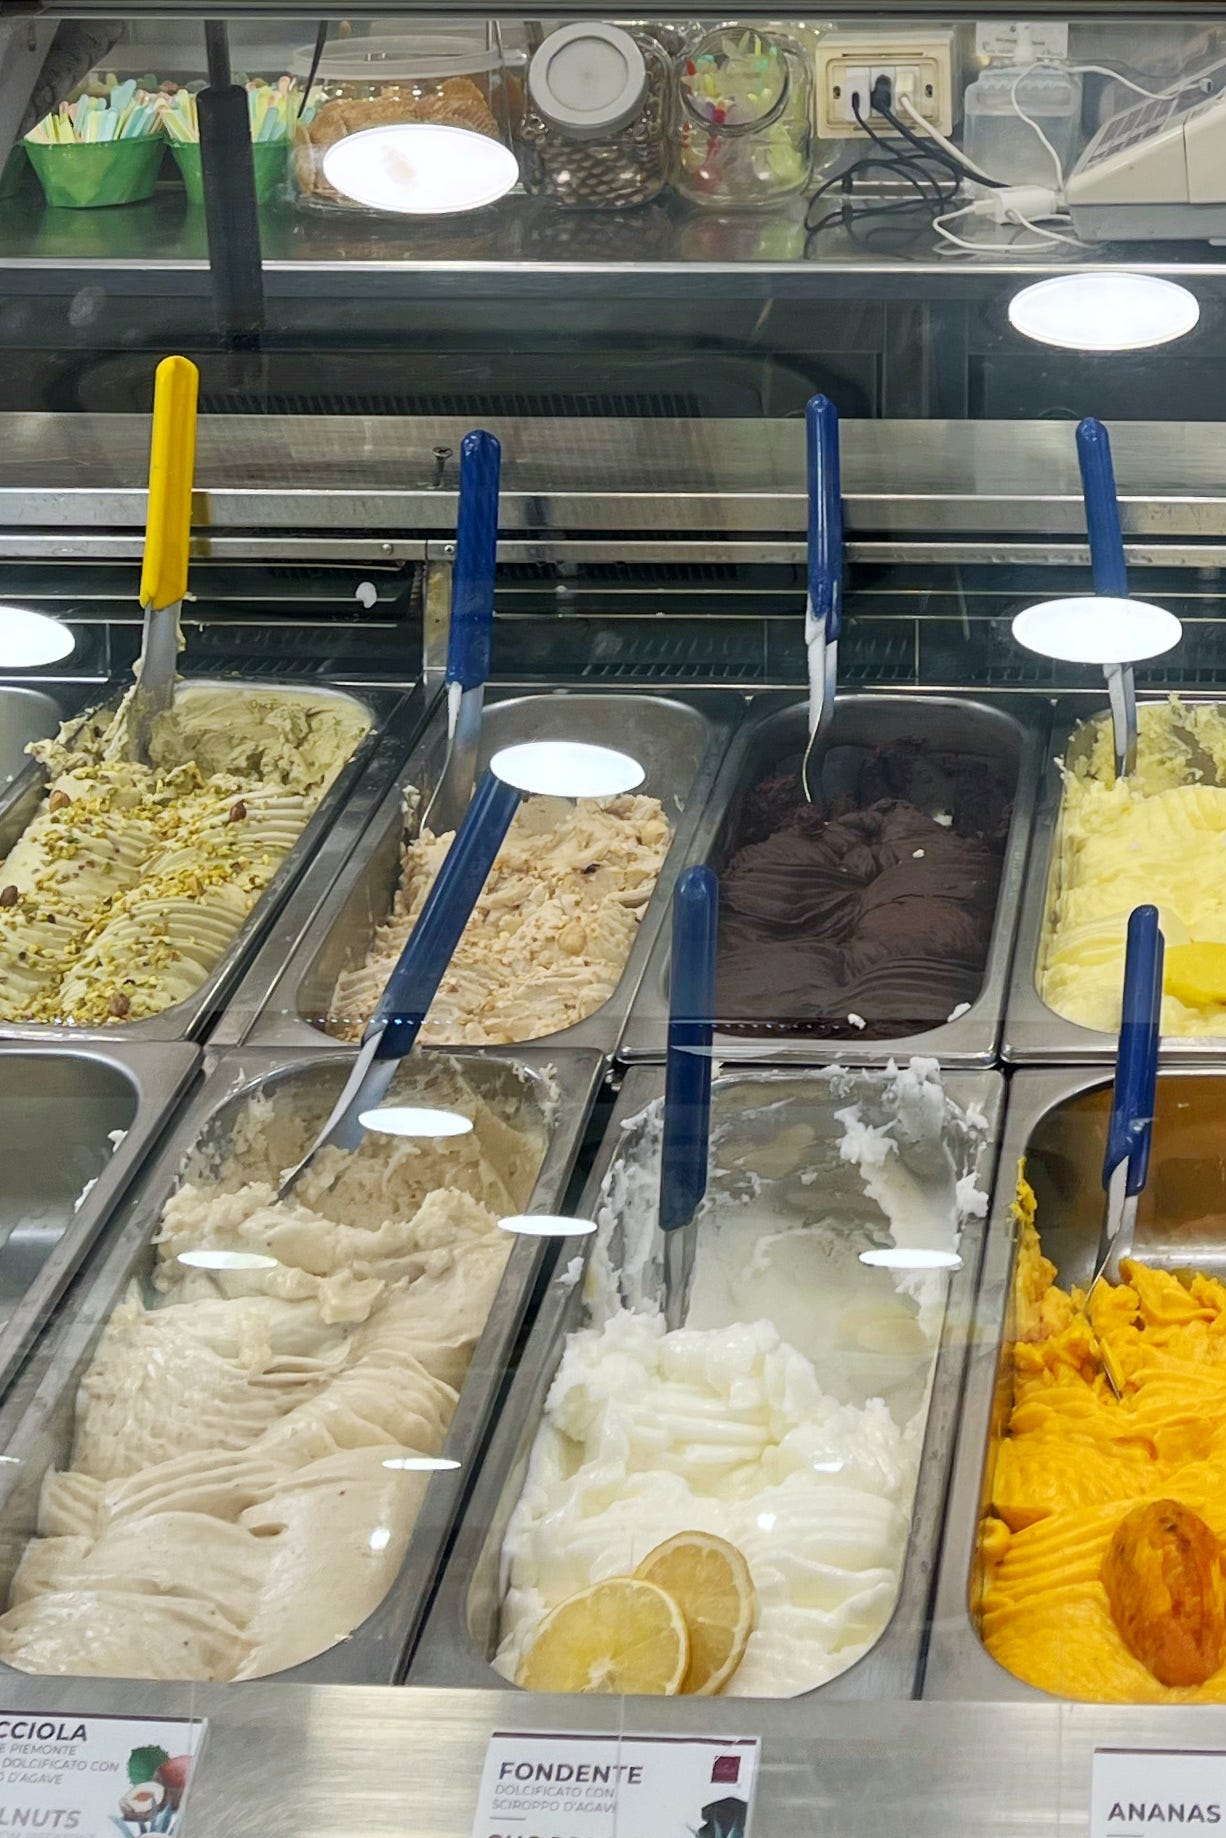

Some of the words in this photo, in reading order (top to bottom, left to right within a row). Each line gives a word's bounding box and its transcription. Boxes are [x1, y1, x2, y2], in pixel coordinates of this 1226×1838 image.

[9, 1744, 79, 1756] PIEMONTE
[2, 1758, 87, 1771] DOLCIFICATO
[89, 1761, 120, 1773] CON
[499, 1761, 644, 1785] FONDENTE
[8, 1772, 64, 1785] D'AGAVE
[495, 1784, 581, 1798] DOLCIFICATO
[585, 1787, 615, 1799] CON
[492, 1799, 560, 1812] SCIROPPO
[1107, 1802, 1222, 1824] ANANAS
